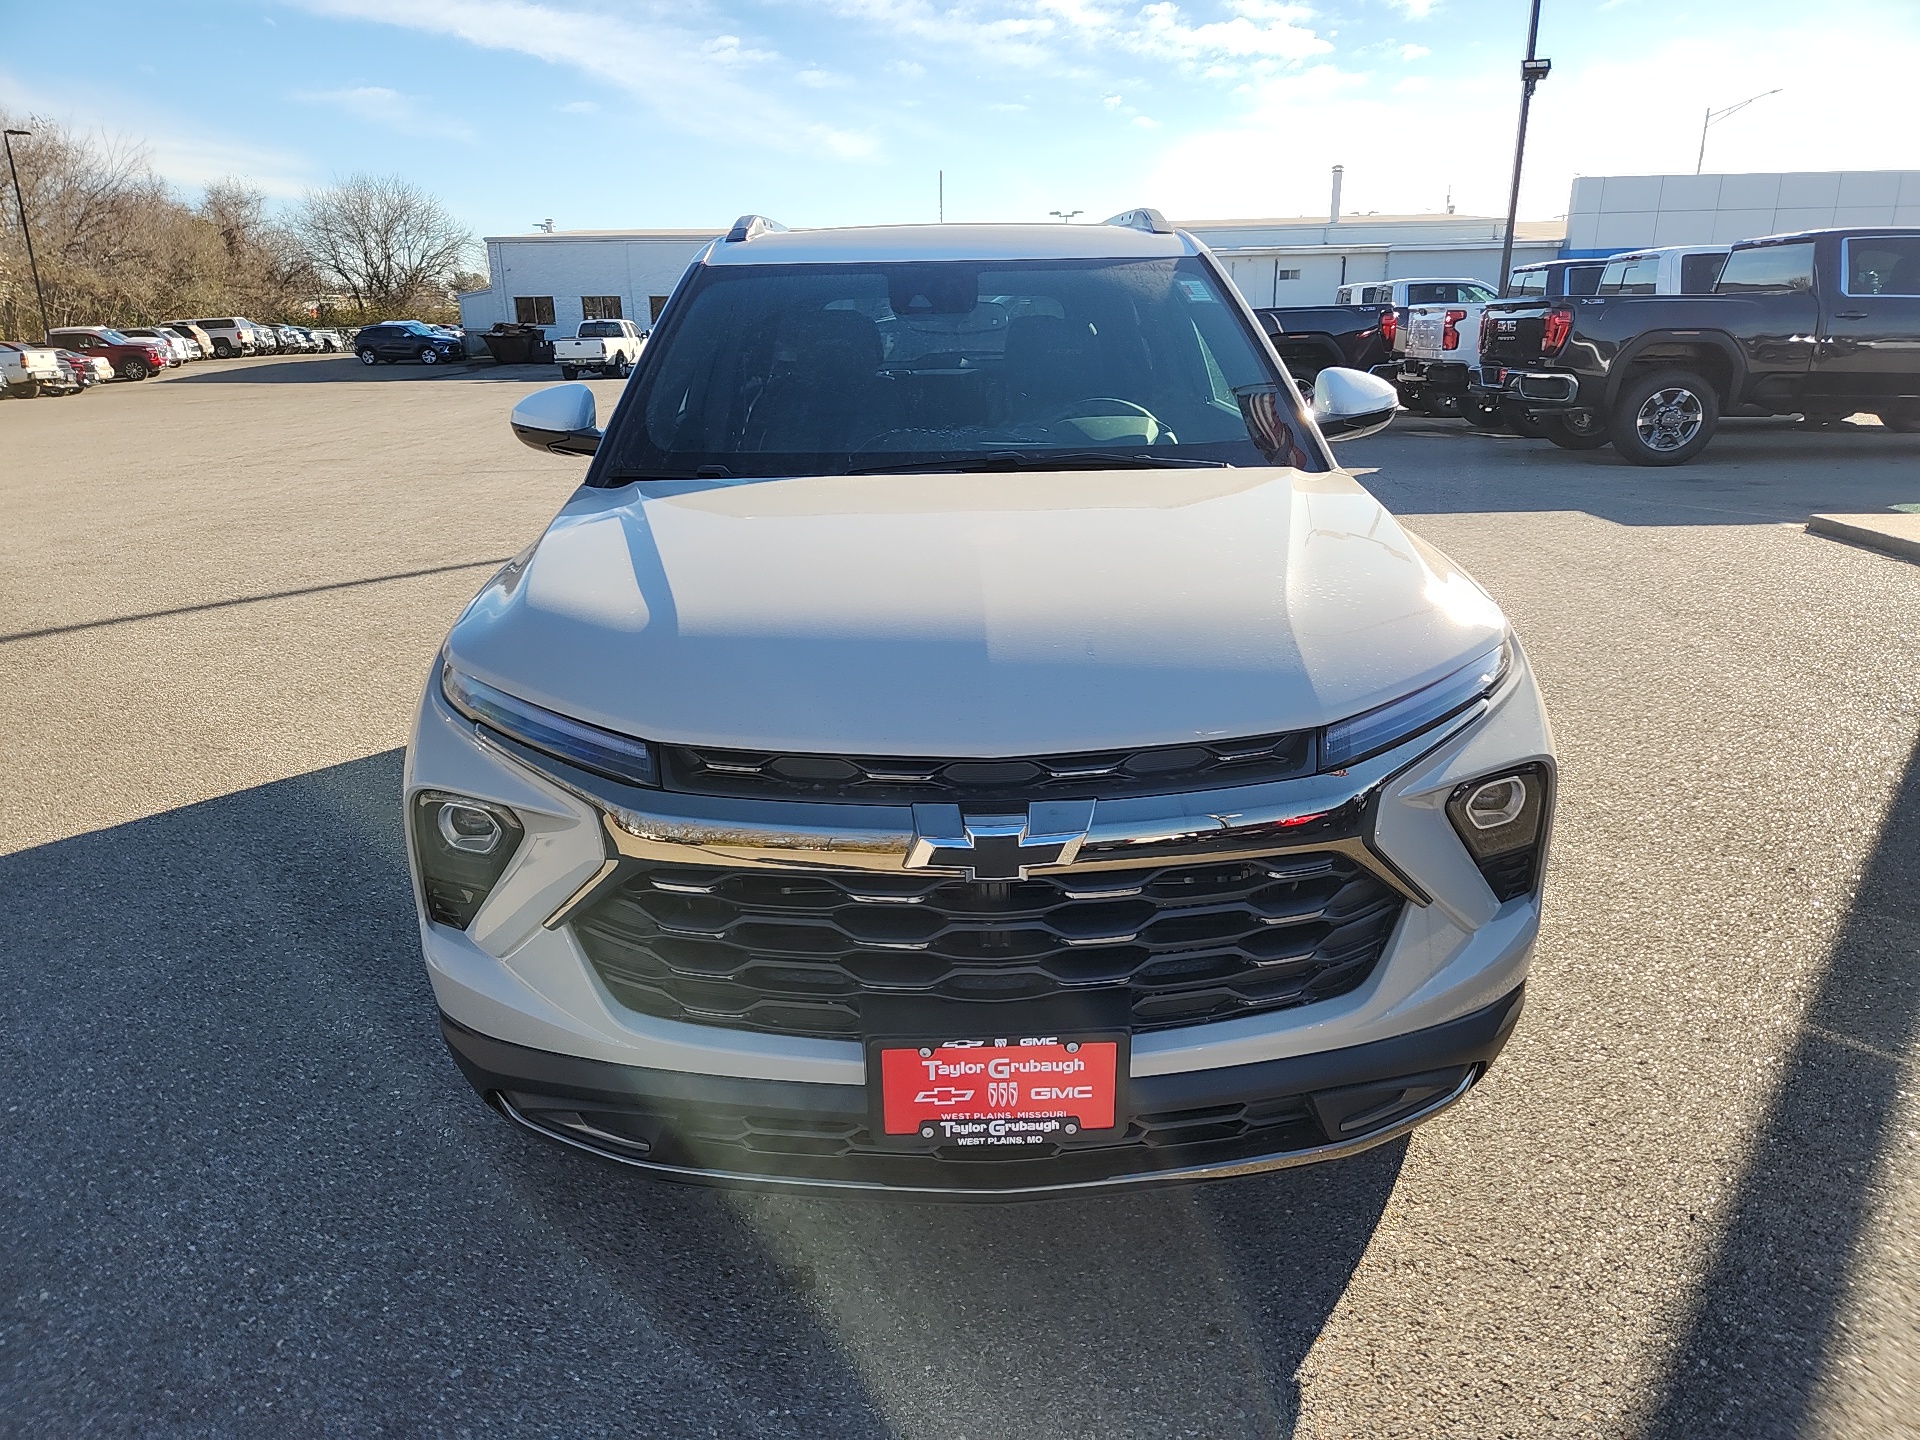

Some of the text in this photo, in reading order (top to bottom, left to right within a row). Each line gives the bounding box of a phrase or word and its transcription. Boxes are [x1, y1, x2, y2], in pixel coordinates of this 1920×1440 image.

[1019, 1037, 1058, 1047] GMC
[921, 1058, 1084, 1080] Taylor Grubaugh
[1030, 1086, 1092, 1099] GMC
[941, 1113, 971, 1121] WEST
[1017, 1111, 1067, 1119] MISSOURI
[940, 1121, 1060, 1137] Taylor Grubaugh
[957, 1136, 1043, 1146] WEST PLAINS, MO
